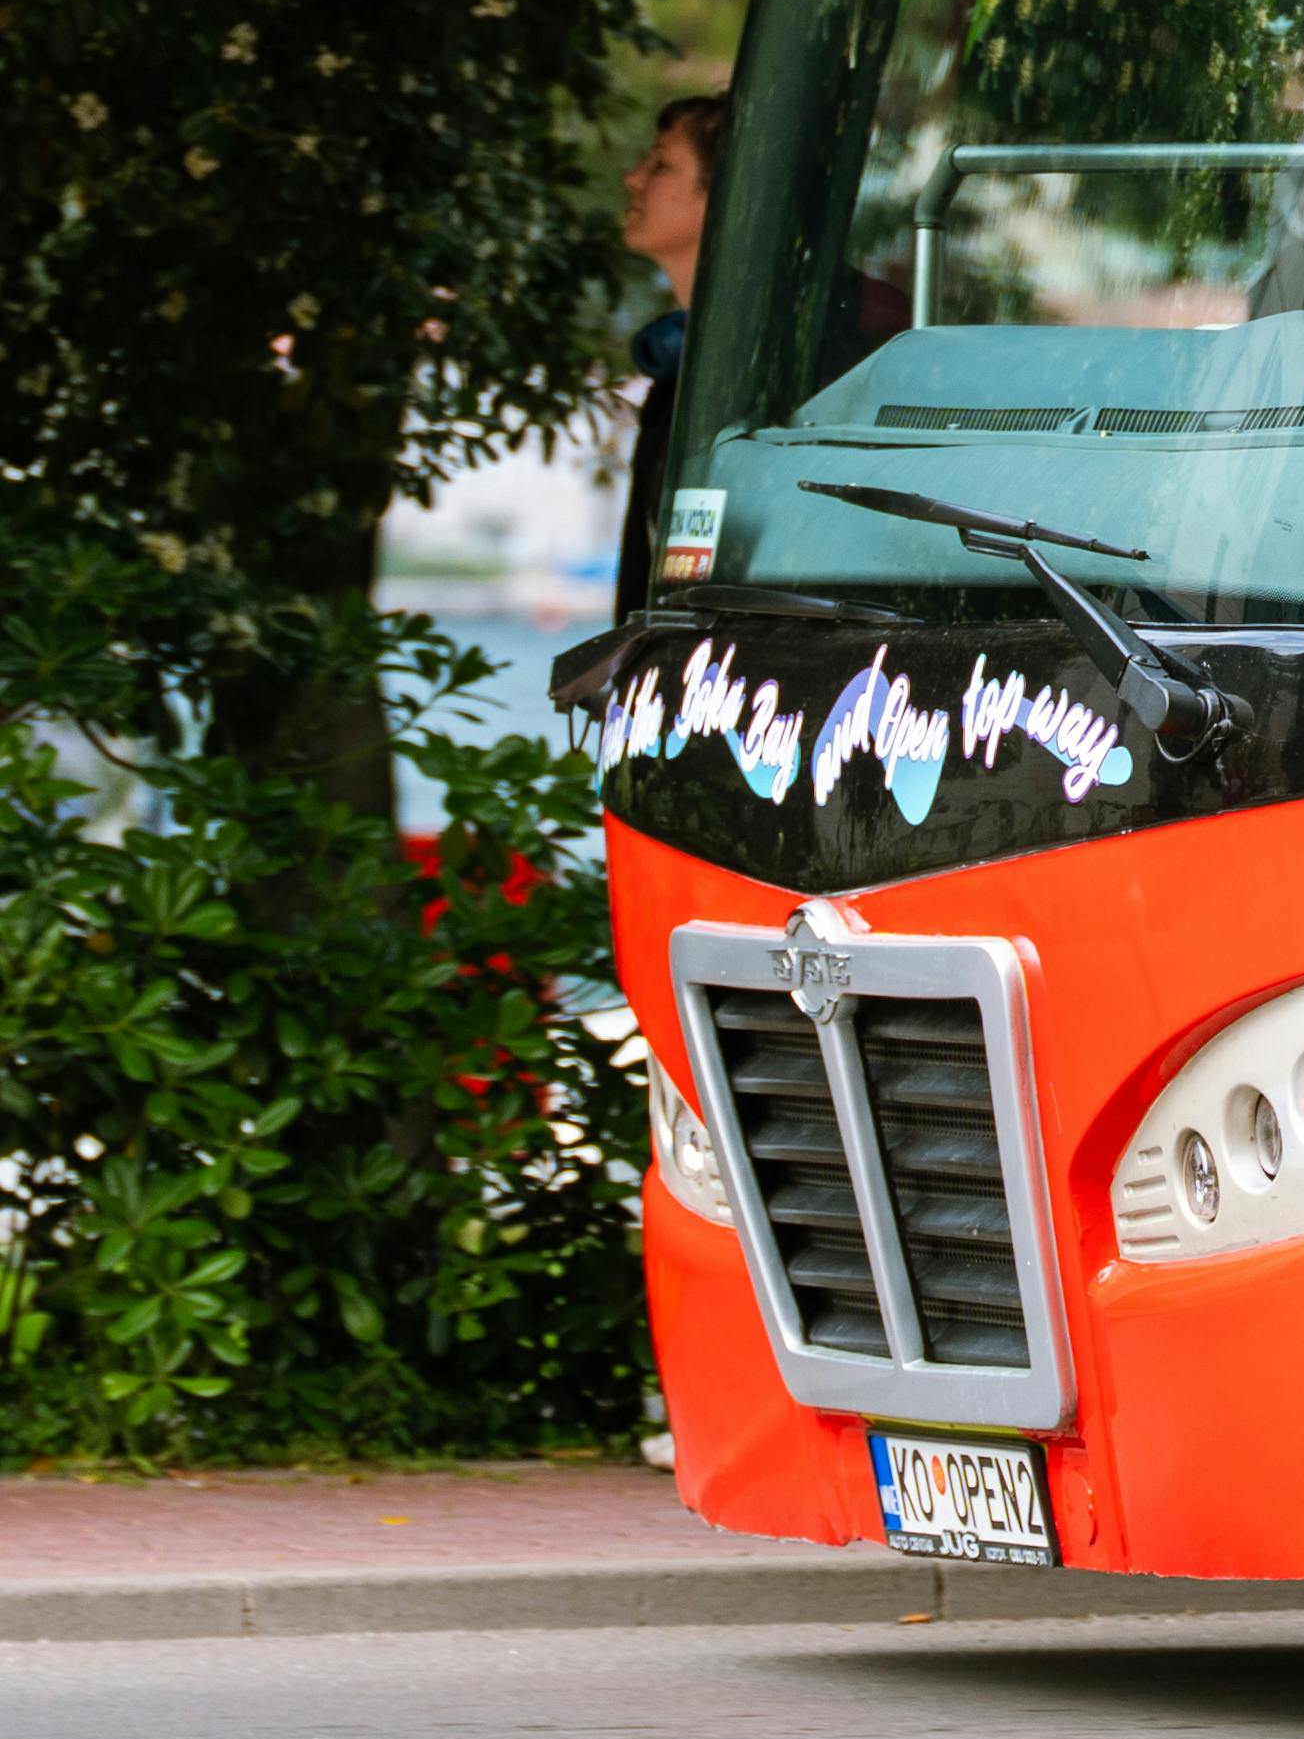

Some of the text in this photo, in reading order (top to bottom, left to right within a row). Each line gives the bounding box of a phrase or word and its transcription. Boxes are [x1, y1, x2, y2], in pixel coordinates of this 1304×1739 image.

[740, 679, 804, 805] Bay
[963, 653, 1026, 769] top
[1027, 685, 1118, 803] way
[891, 1446, 1043, 1535] KO OPEN2
[938, 1530, 980, 1559] JUG
